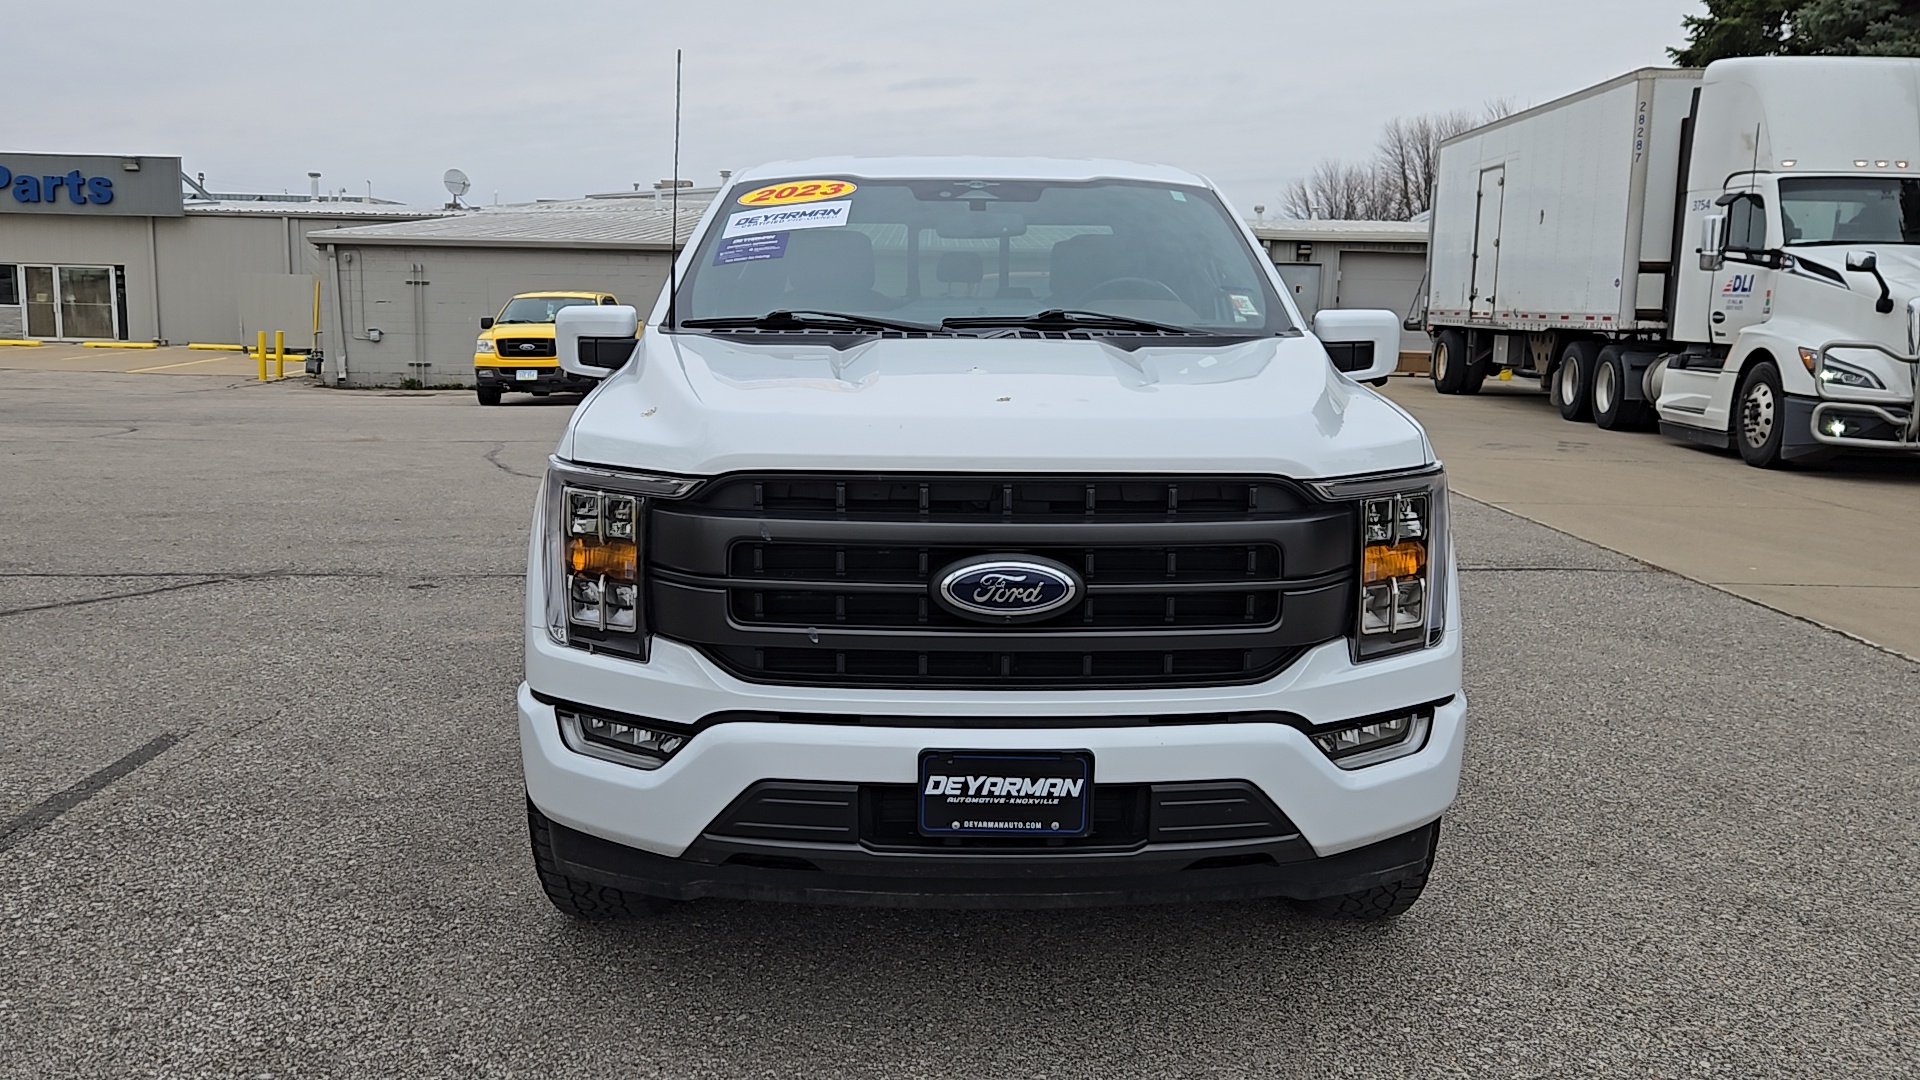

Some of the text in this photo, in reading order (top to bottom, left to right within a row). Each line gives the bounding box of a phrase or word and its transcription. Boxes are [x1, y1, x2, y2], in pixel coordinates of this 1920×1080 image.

[1635, 101, 1647, 163] 28287
[749, 184, 845, 203] 2023
[1692, 199, 1711, 212] 3754
[735, 208, 842, 226] DEYARMAN
[741, 219, 785, 229] CERTIFIED
[1732, 274, 1755, 293] DLI
[973, 573, 1045, 603] Ford
[924, 775, 1084, 797] DEYARMAN
[963, 820, 1042, 830] DEYARMANAUTO.COM
